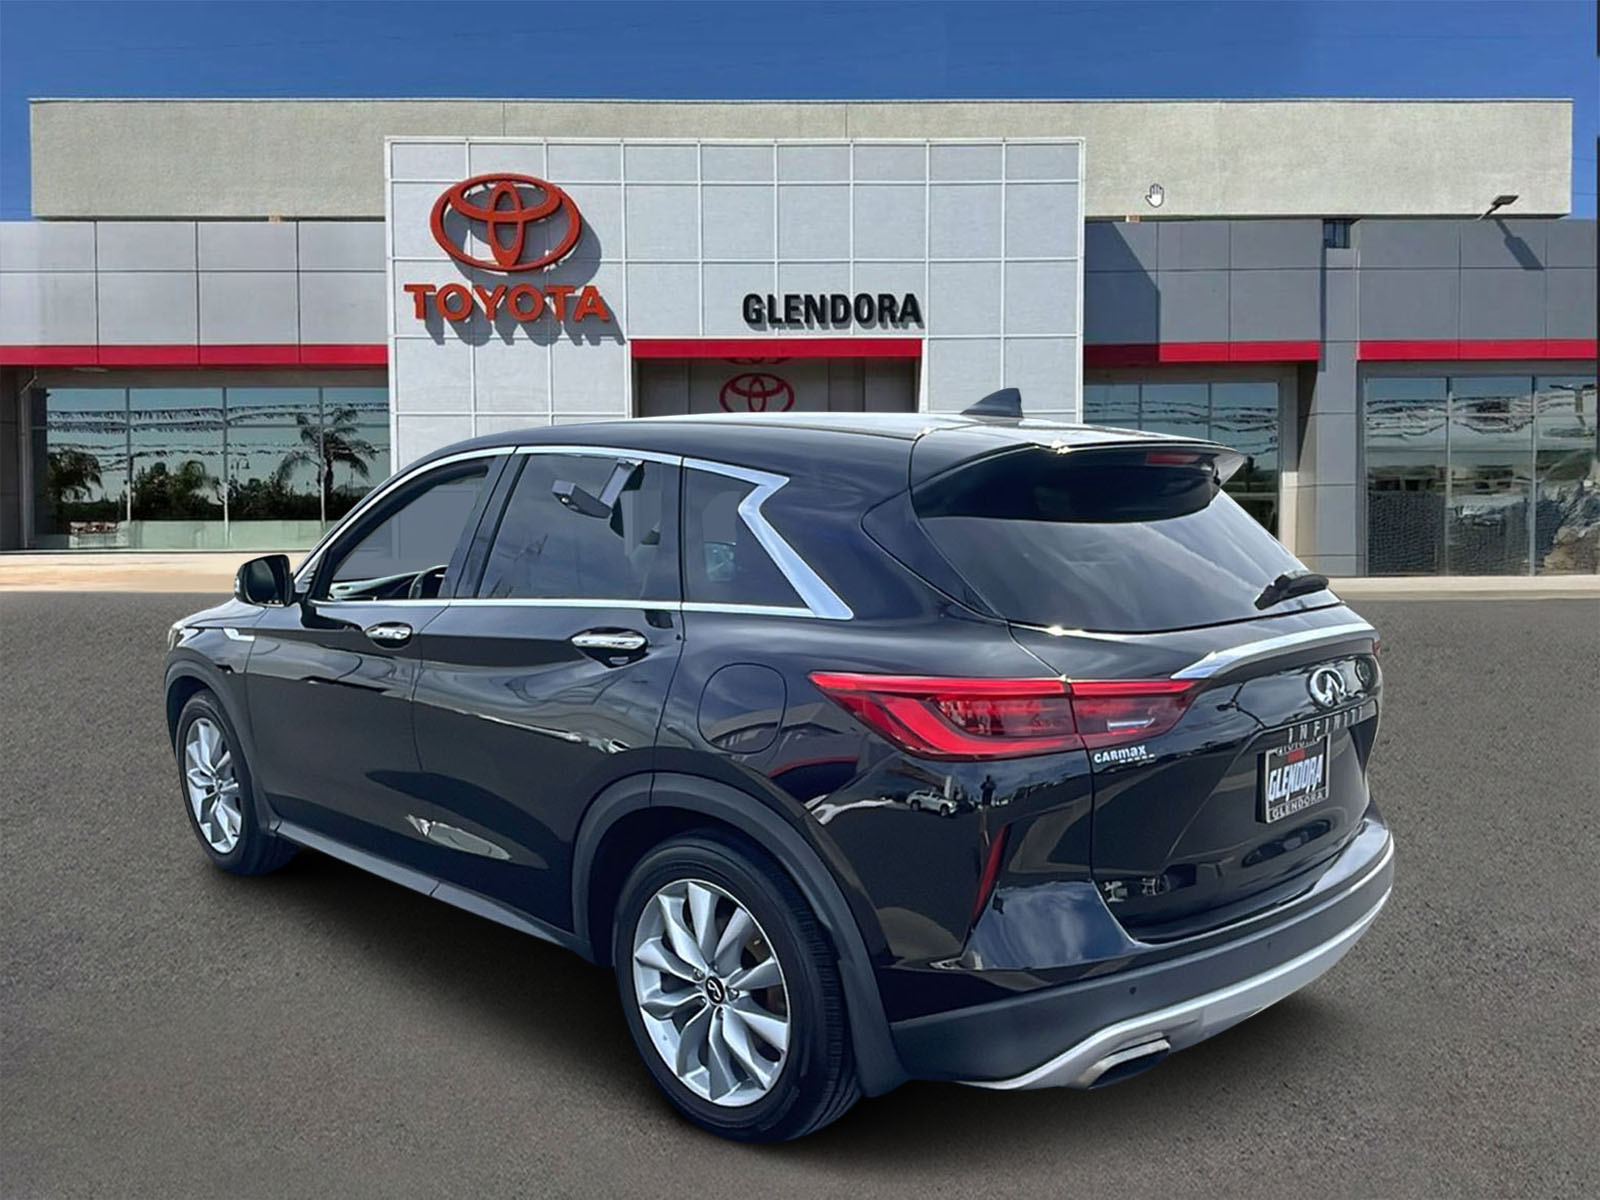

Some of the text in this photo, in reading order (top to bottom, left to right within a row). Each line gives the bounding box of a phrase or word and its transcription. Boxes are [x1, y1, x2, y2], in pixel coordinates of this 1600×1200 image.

[404, 283, 610, 322] TOYOTA
[742, 293, 923, 325] GLENDORA
[1287, 706, 1363, 744] INFINITI
[1268, 754, 1324, 802] GLENDORA
[1271, 792, 1324, 820] GLENDORA
